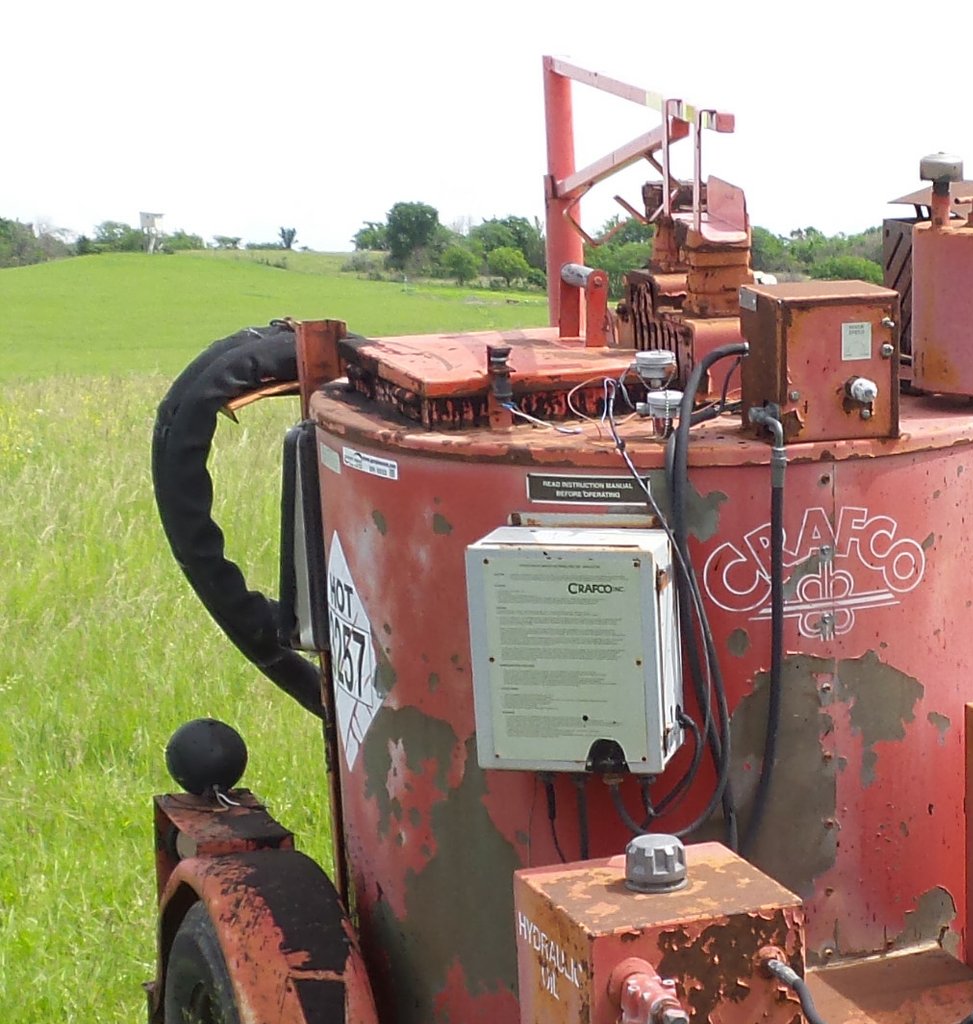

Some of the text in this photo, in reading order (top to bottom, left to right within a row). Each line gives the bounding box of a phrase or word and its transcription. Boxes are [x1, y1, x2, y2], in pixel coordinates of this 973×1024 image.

[543, 480, 633, 490] READ INSTRUCTION MANUAL
[556, 490, 620, 499] BEFORE OPERATING
[703, 505, 926, 612] CRAFCO
